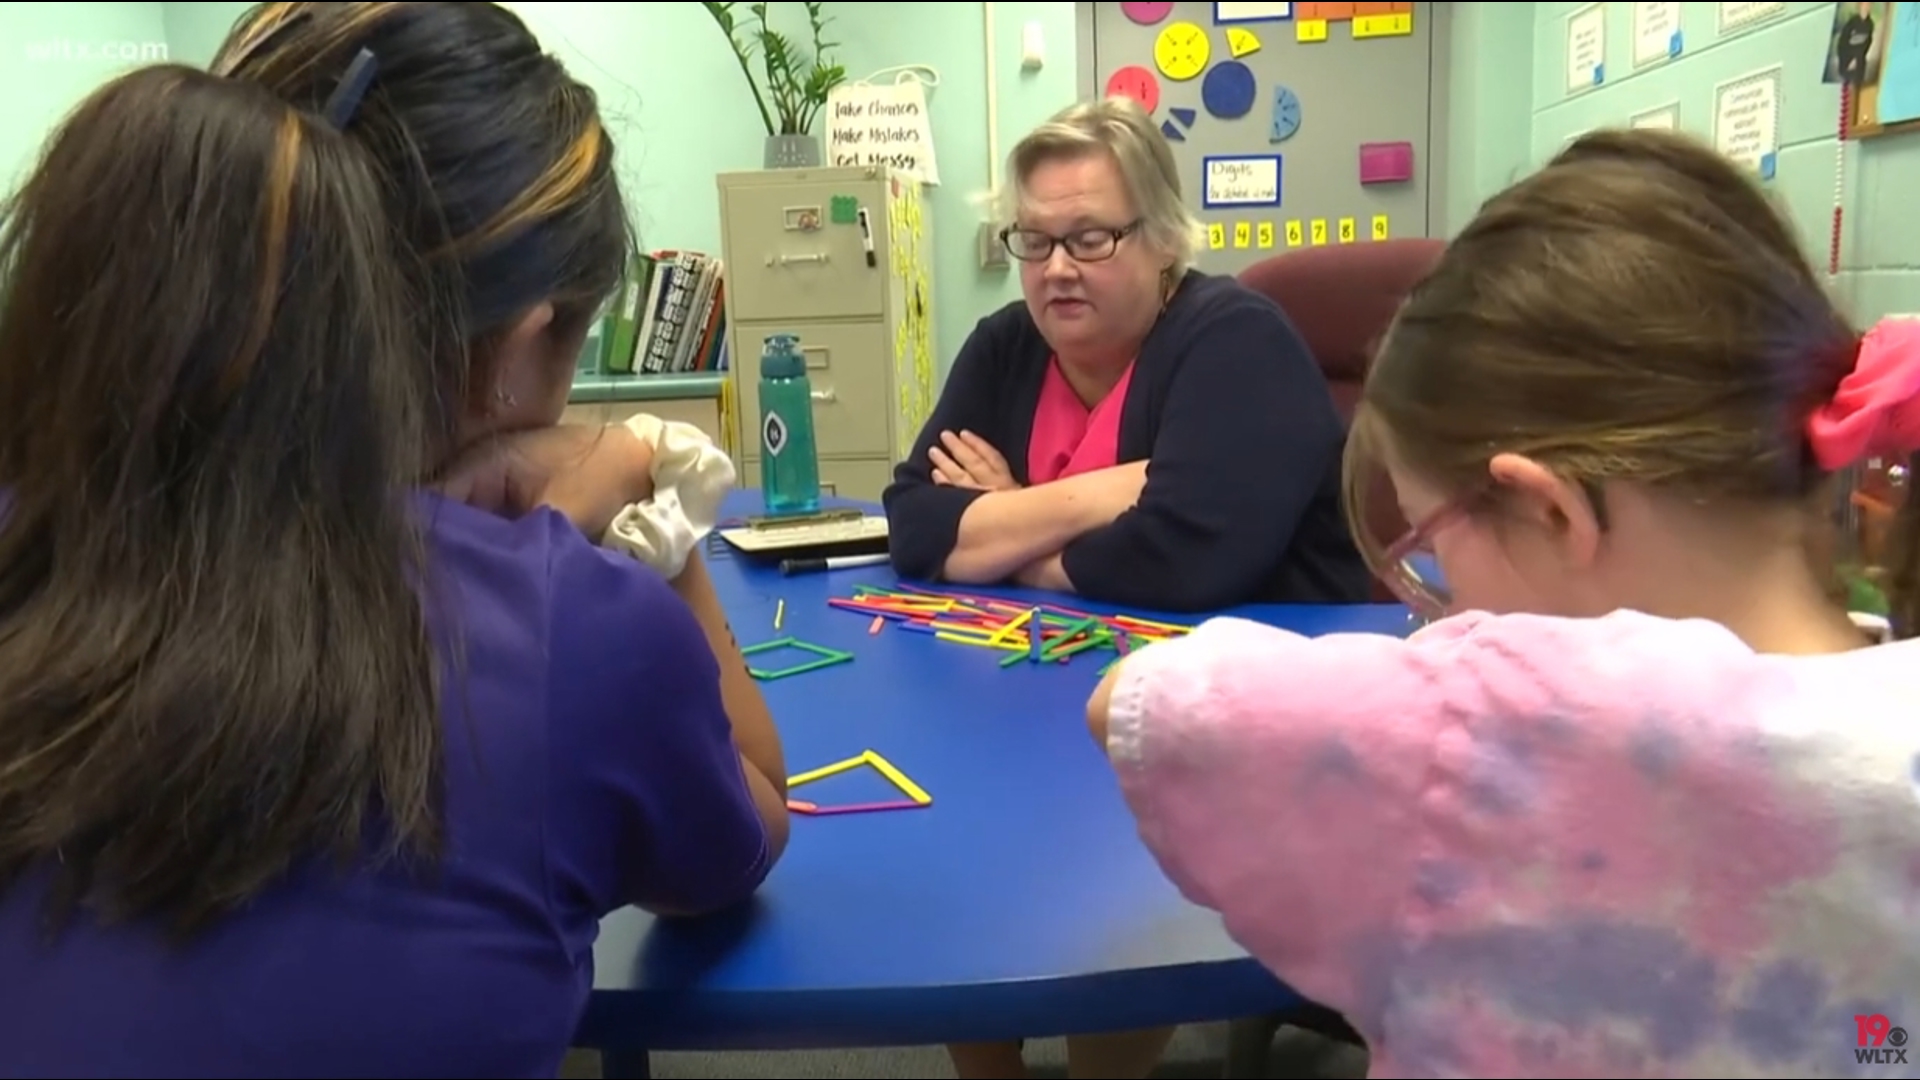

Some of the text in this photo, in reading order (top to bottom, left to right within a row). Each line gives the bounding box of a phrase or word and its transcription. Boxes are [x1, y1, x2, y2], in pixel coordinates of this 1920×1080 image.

[835, 99, 919, 120] Take Chances
[832, 127, 920, 145] Make Mistakes
[868, 152, 915, 170] Messy
